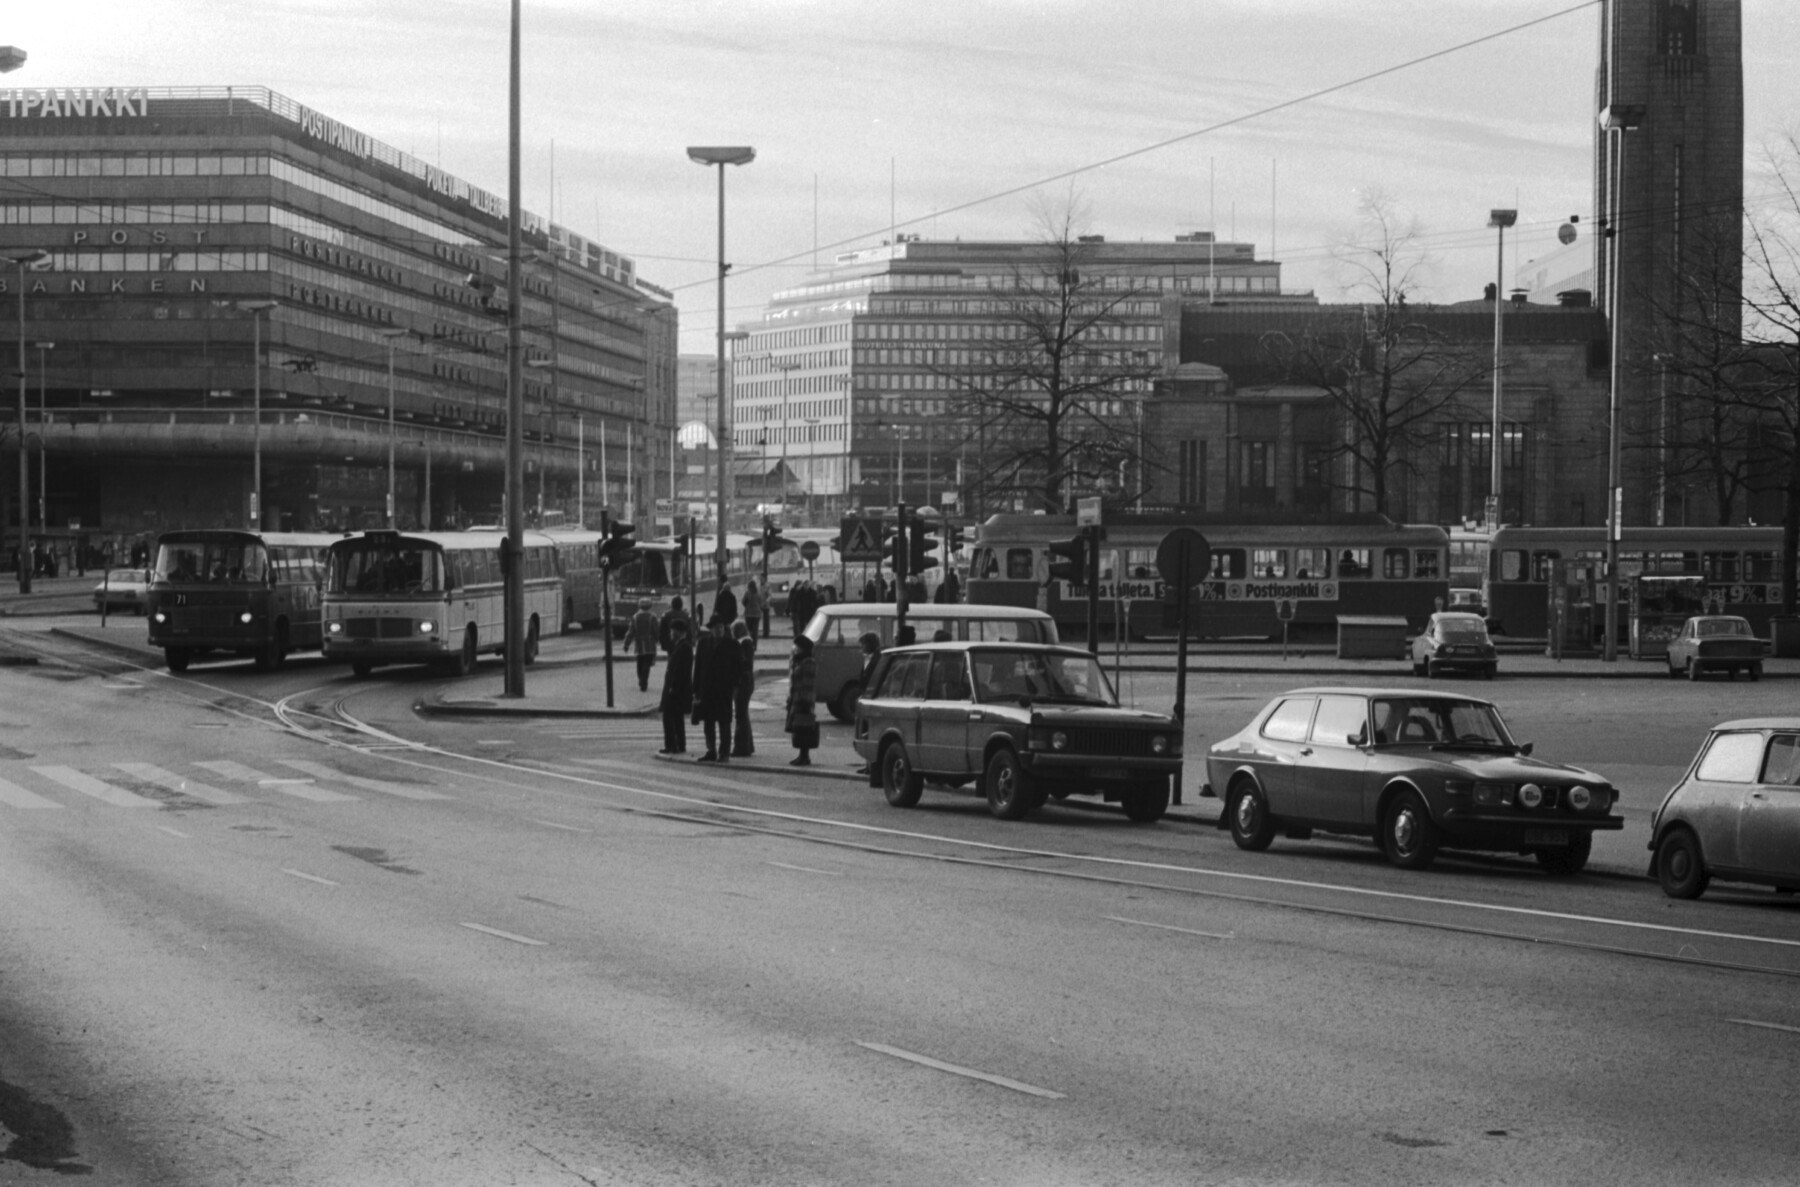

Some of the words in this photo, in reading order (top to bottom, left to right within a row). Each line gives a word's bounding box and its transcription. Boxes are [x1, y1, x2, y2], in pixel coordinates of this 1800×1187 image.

[301, 105, 367, 160] POSTIPANKKI
[74, 229, 207, 245] POST
[903, 341, 947, 349] VAAKUNA
[1245, 582, 1319, 599] Postipankki
[176, 594, 187, 605] 71
